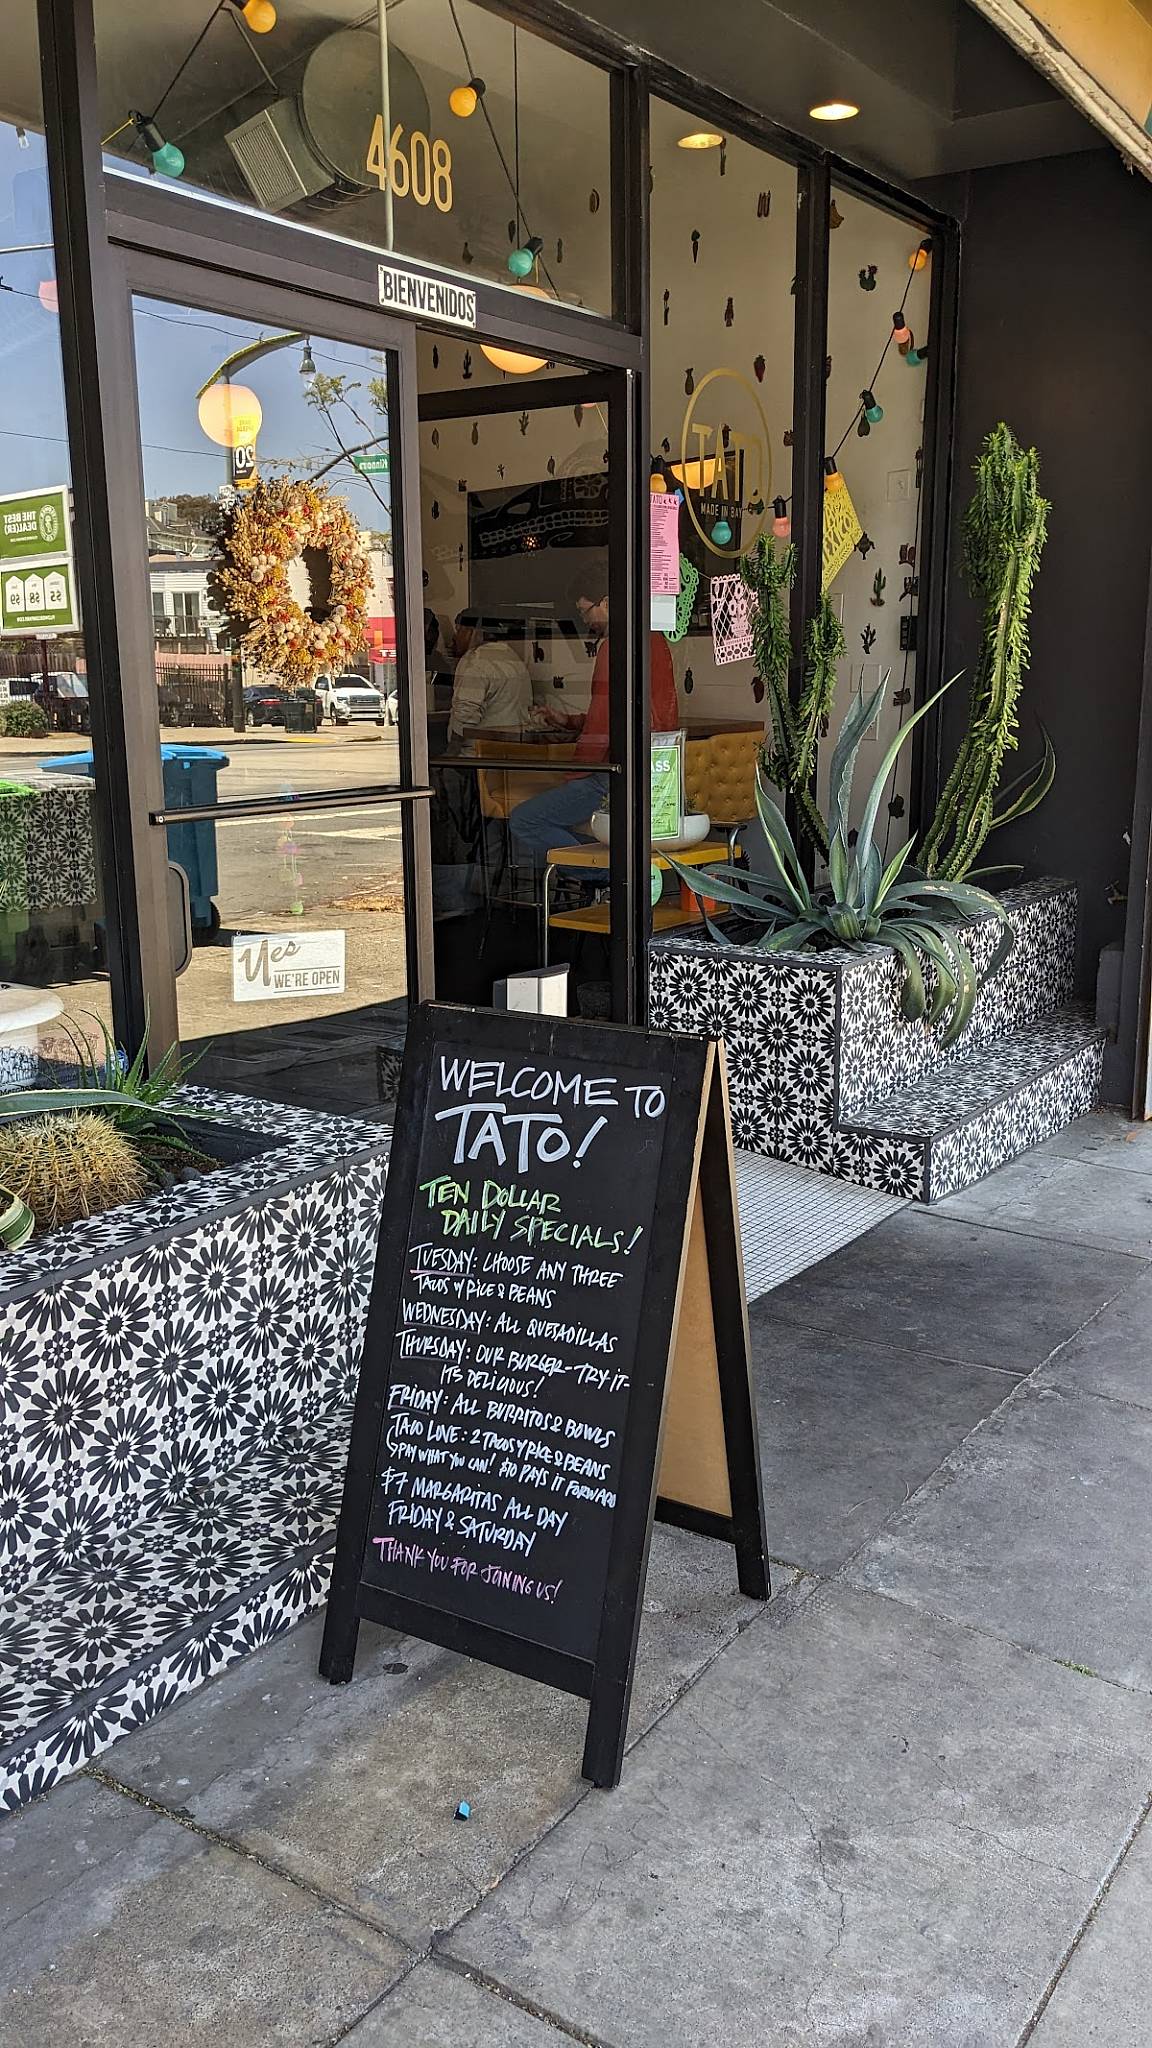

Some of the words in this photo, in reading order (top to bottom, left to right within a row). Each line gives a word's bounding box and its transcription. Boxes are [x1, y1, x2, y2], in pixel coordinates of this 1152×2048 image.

[367, 114, 453, 212] 4608
[383, 269, 475, 324] BIENVENIDOS
[701, 502, 719, 516] MADE
[721, 505, 729, 517] IN
[273, 972, 309, 988] WE'RE
[312, 970, 340, 986] OPEN
[440, 1056, 619, 1106] WELCOME
[625, 1085, 666, 1118] TO
[435, 1103, 609, 1174] TATO!
[420, 1175, 470, 1208] TEN
[482, 1179, 562, 1213] DOLLAR
[441, 1209, 506, 1240] DAILY
[509, 1214, 643, 1254] SPECIALS!
[409, 1242, 478, 1274] TUESDAY:
[482, 1250, 534, 1276] CHOOSE
[536, 1260, 568, 1281] ANY
[571, 1264, 624, 1288] THREE
[413, 1273, 451, 1295] TACOS
[508, 1284, 557, 1309] BEANS
[396, 1329, 471, 1364] THURSDAY:
[475, 1344, 505, 1366] OUR
[402, 1301, 491, 1334] WEDNESDAY:
[494, 1311, 521, 1333] ALL
[526, 1318, 618, 1353] QUESADILLAS
[387, 1384, 449, 1414] FRIDAY:
[450, 1393, 481, 1416] ALL
[486, 1400, 552, 1430] BURRITOS
[550, 1416, 562, 1432] &
[564, 1418, 616, 1448] BOWLS
[391, 1413, 423, 1438] TACO
[427, 1419, 468, 1444] LOVE:
[469, 1428, 481, 1445] 2
[482, 1432, 516, 1451] TACOS
[563, 1453, 611, 1481] BEANS
[398, 1442, 418, 1460] PAY
[418, 1448, 449, 1466] WHAT
[449, 1451, 465, 1470] YOU
[518, 1462, 549, 1488] PAYS
[551, 1473, 566, 1491] IT
[380, 1466, 409, 1495] $7
[411, 1476, 502, 1512] MARGARITAS
[502, 1496, 534, 1520] ALL
[536, 1507, 569, 1536] DAY
[387, 1499, 443, 1534] FRIDAY
[444, 1510, 455, 1531] &
[457, 1515, 537, 1557] SATURDAY
[372, 1537, 426, 1568] THANK
[427, 1548, 449, 1573] YOU
[450, 1557, 478, 1582] FOR
[536, 1579, 564, 1604] US!
